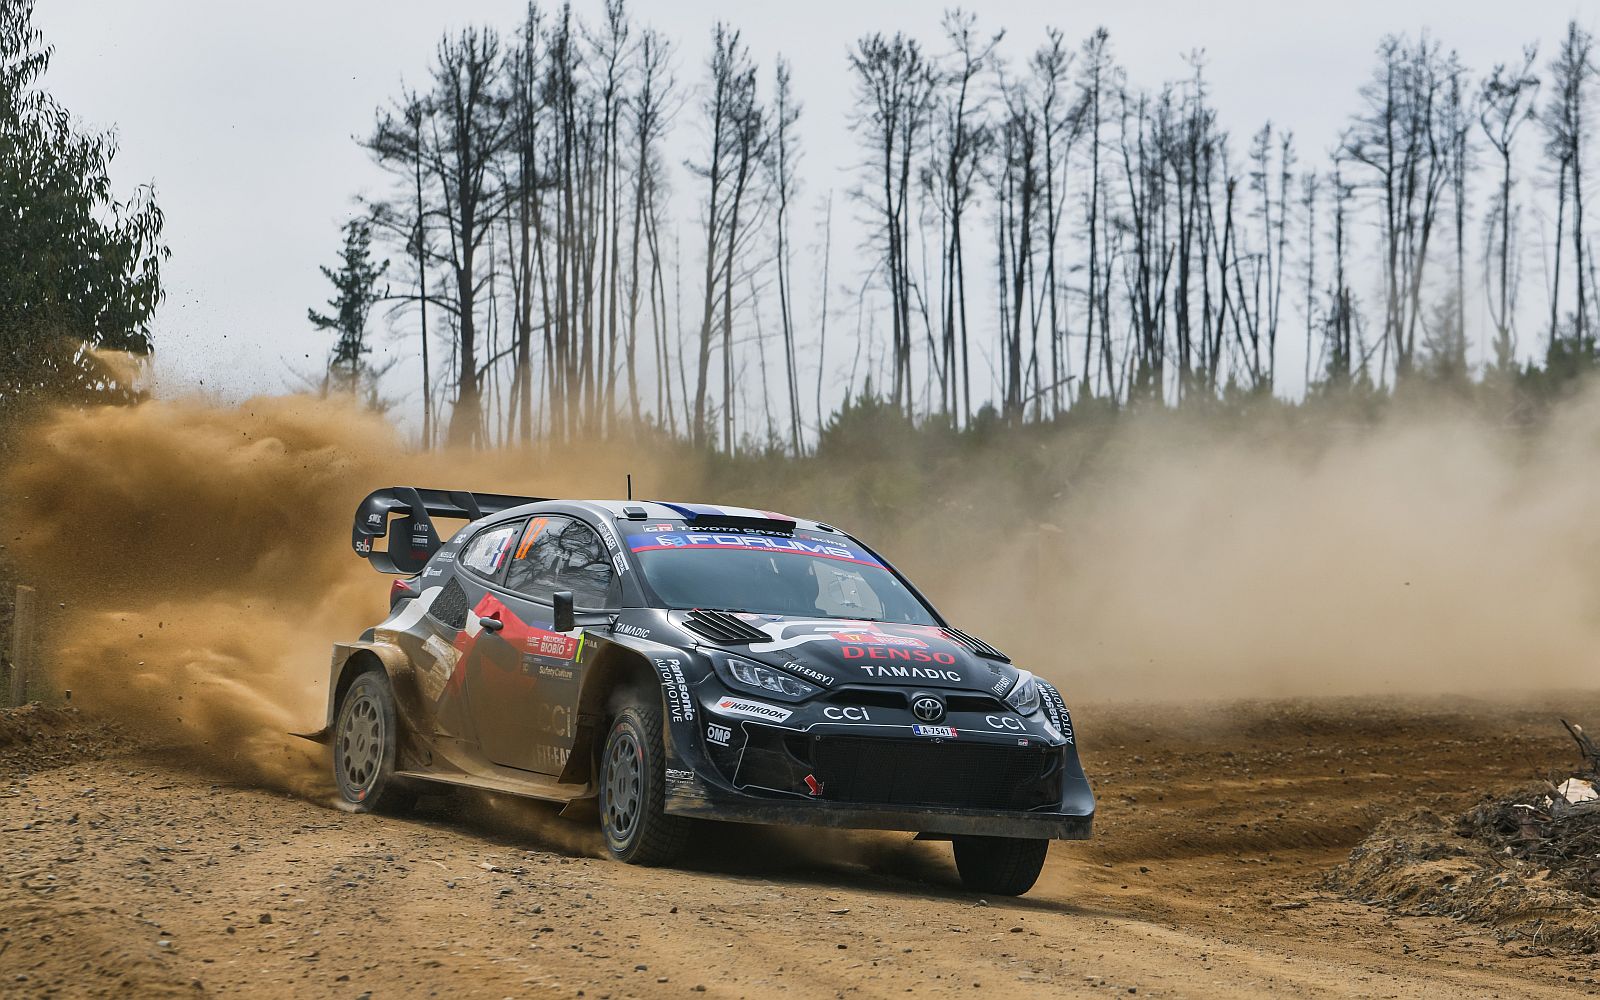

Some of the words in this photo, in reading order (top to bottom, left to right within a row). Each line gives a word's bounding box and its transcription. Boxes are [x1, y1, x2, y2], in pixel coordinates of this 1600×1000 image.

[686, 534, 855, 559] FORUM8
[615, 622, 650, 638] TAMADIC
[841, 646, 956, 665] DENSO
[860, 665, 962, 682] TAMADIC
[654, 658, 683, 723] AUTOMOTIVE
[666, 659, 694, 722] Panasonic
[1035, 683, 1062, 732] anasonic
[707, 726, 732, 743] OMP
